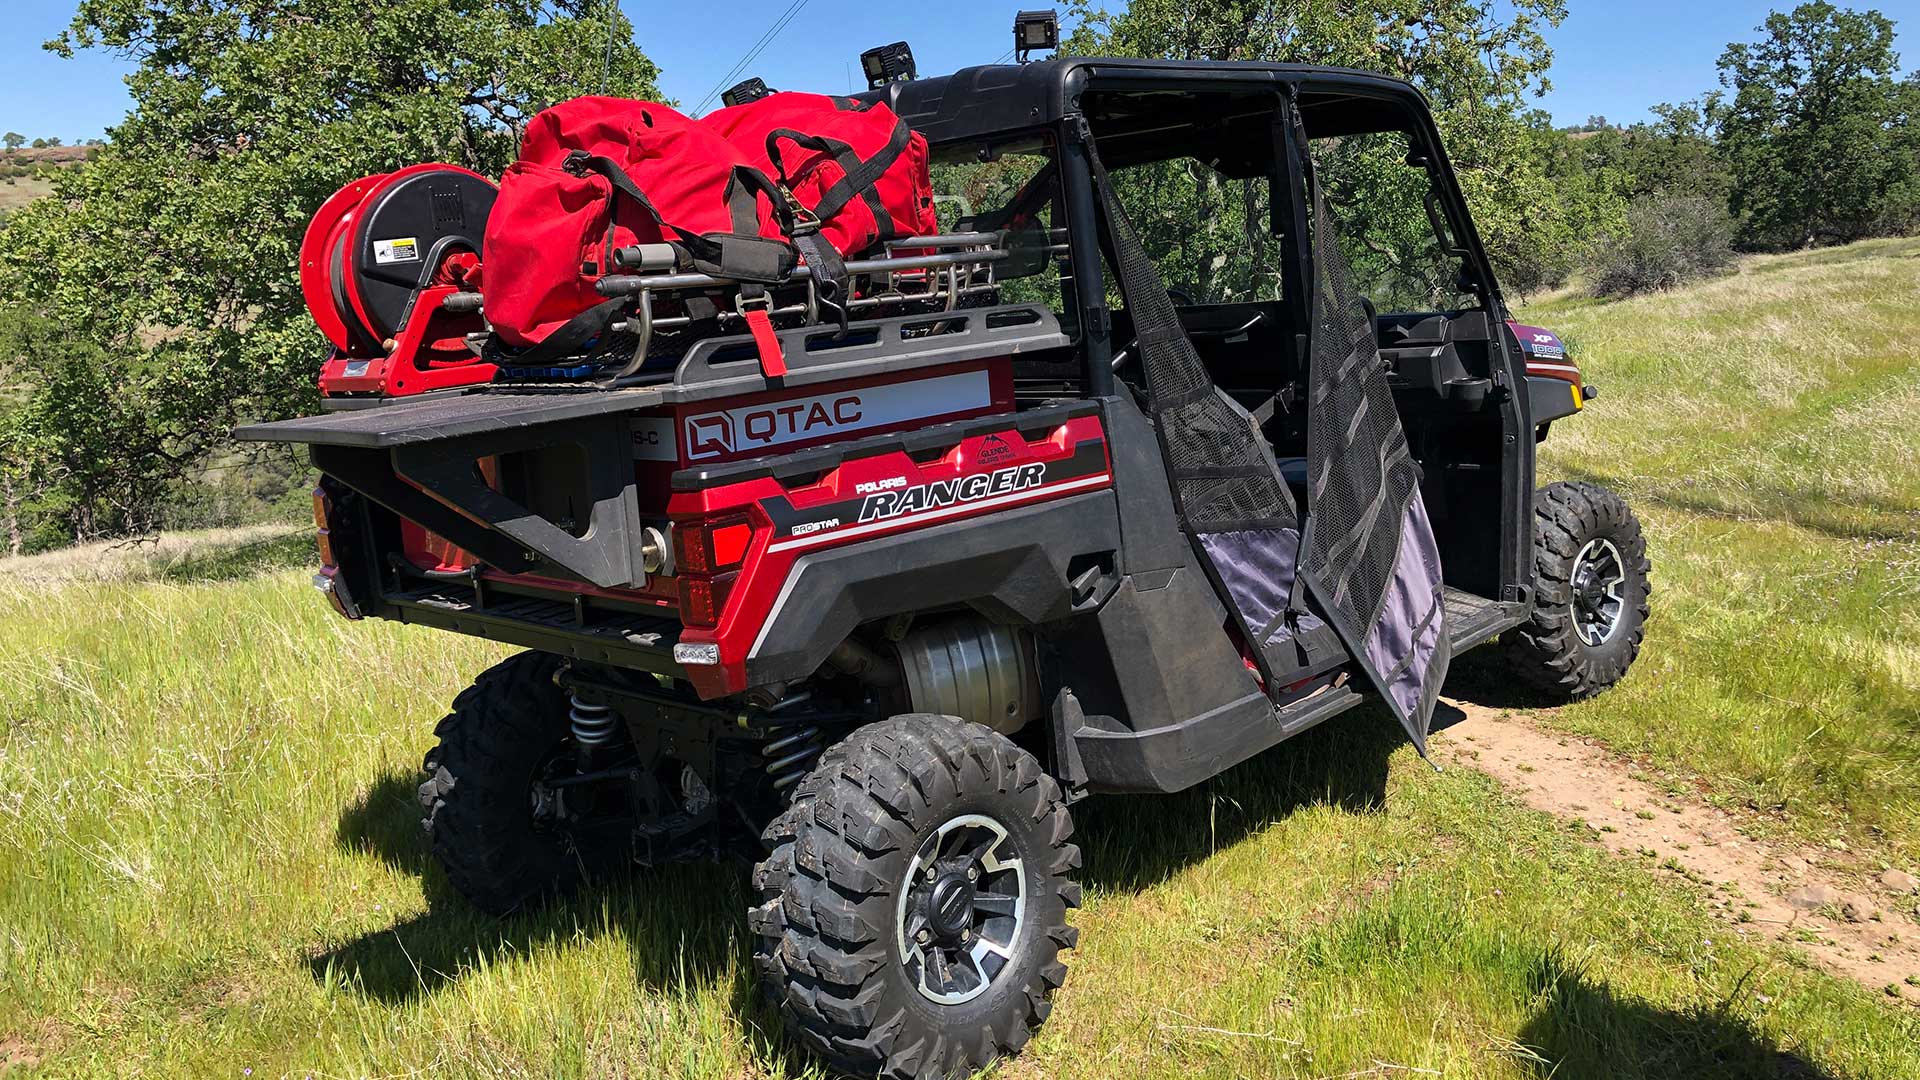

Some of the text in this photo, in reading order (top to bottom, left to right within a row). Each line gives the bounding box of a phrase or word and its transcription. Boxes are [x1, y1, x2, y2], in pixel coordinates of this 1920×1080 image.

[1533, 333, 1552, 342] XP
[1531, 344, 1563, 357] 1000
[744, 396, 863, 443] QTAC
[855, 476, 907, 494] POLARIS
[858, 462, 1046, 523] RANGER
[791, 518, 840, 536] PROSTAR
